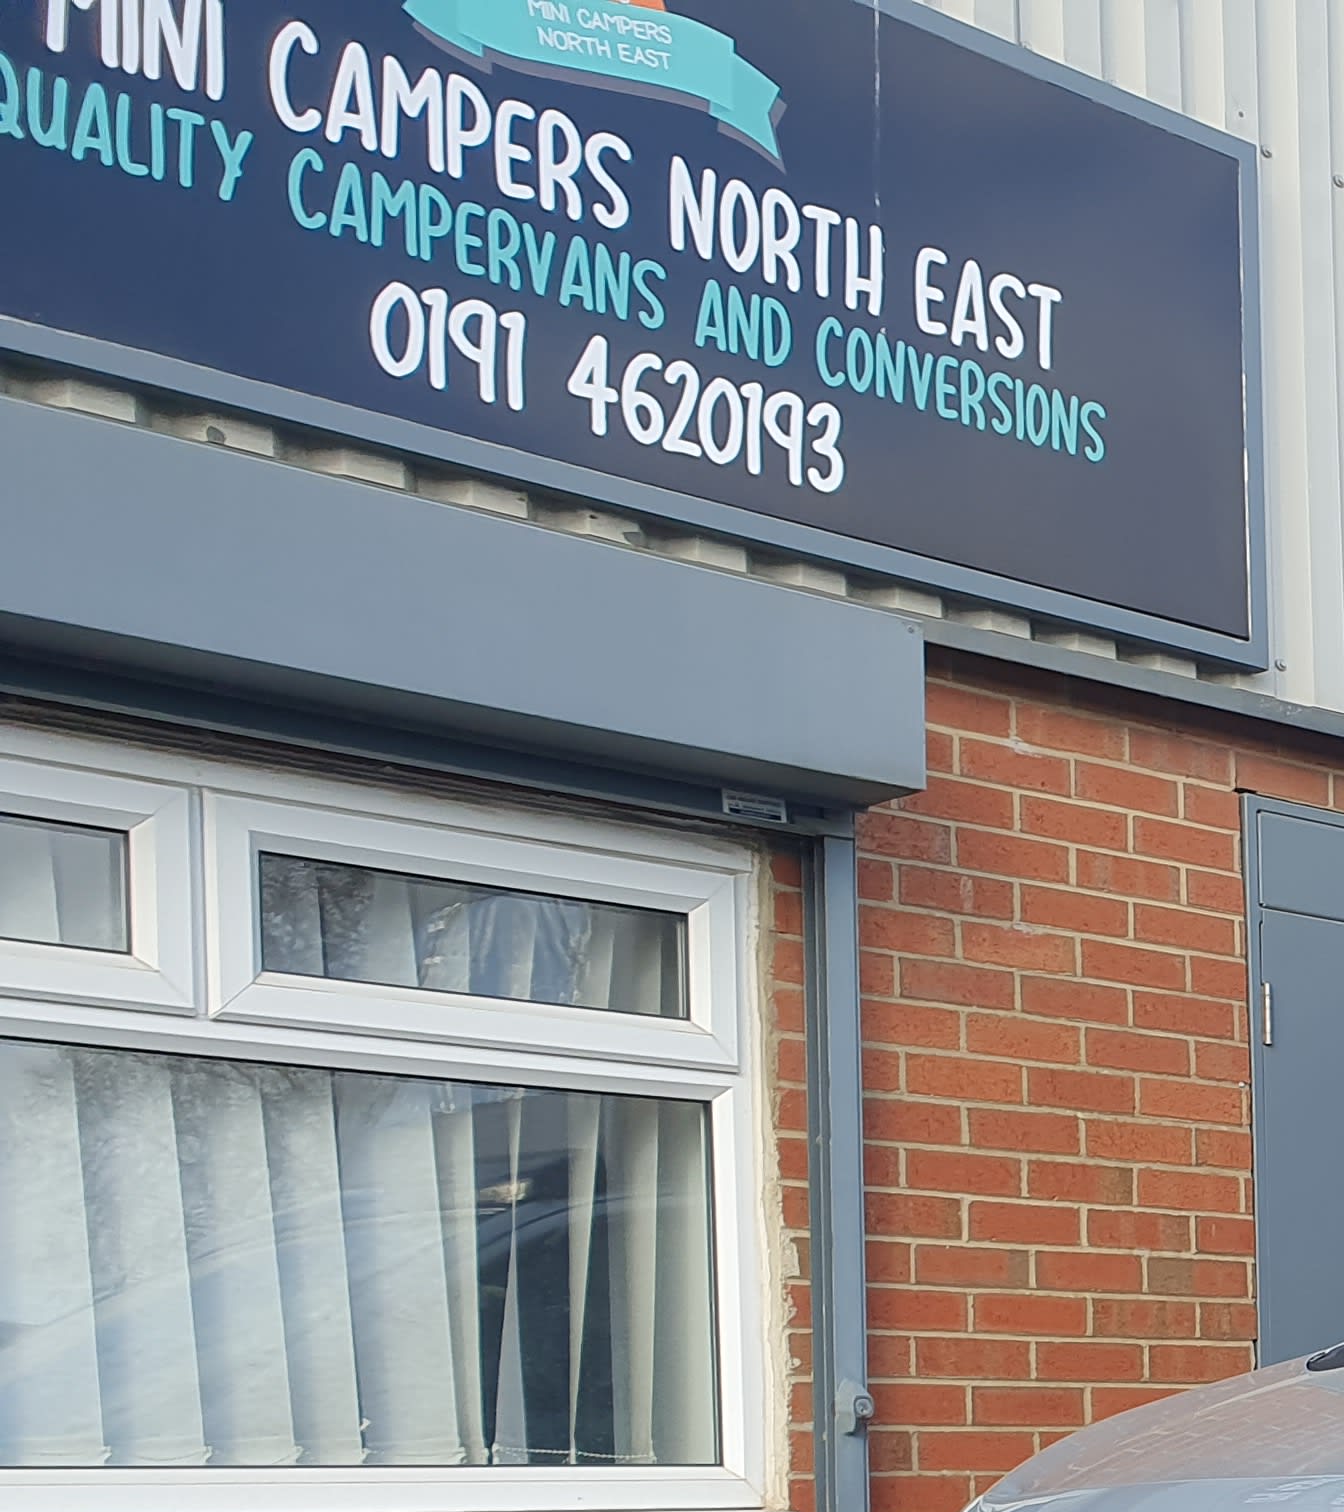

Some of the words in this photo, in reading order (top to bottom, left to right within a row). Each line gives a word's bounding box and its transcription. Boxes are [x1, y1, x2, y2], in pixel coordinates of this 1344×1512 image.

[528, 0, 571, 24] MINI
[577, 8, 673, 44] CAMPERS
[537, 26, 612, 58] NORTH
[617, 43, 672, 70] EAST
[268, 20, 634, 230] CAMPERS
[668, 155, 884, 317] NORTH
[914, 246, 1063, 370] EAST
[288, 147, 668, 330] CAMPERVANS
[695, 279, 793, 367] AND
[815, 316, 1107, 463] CONVERSIONS
[370, 281, 527, 411] 0191
[567, 334, 845, 493] 4620193
